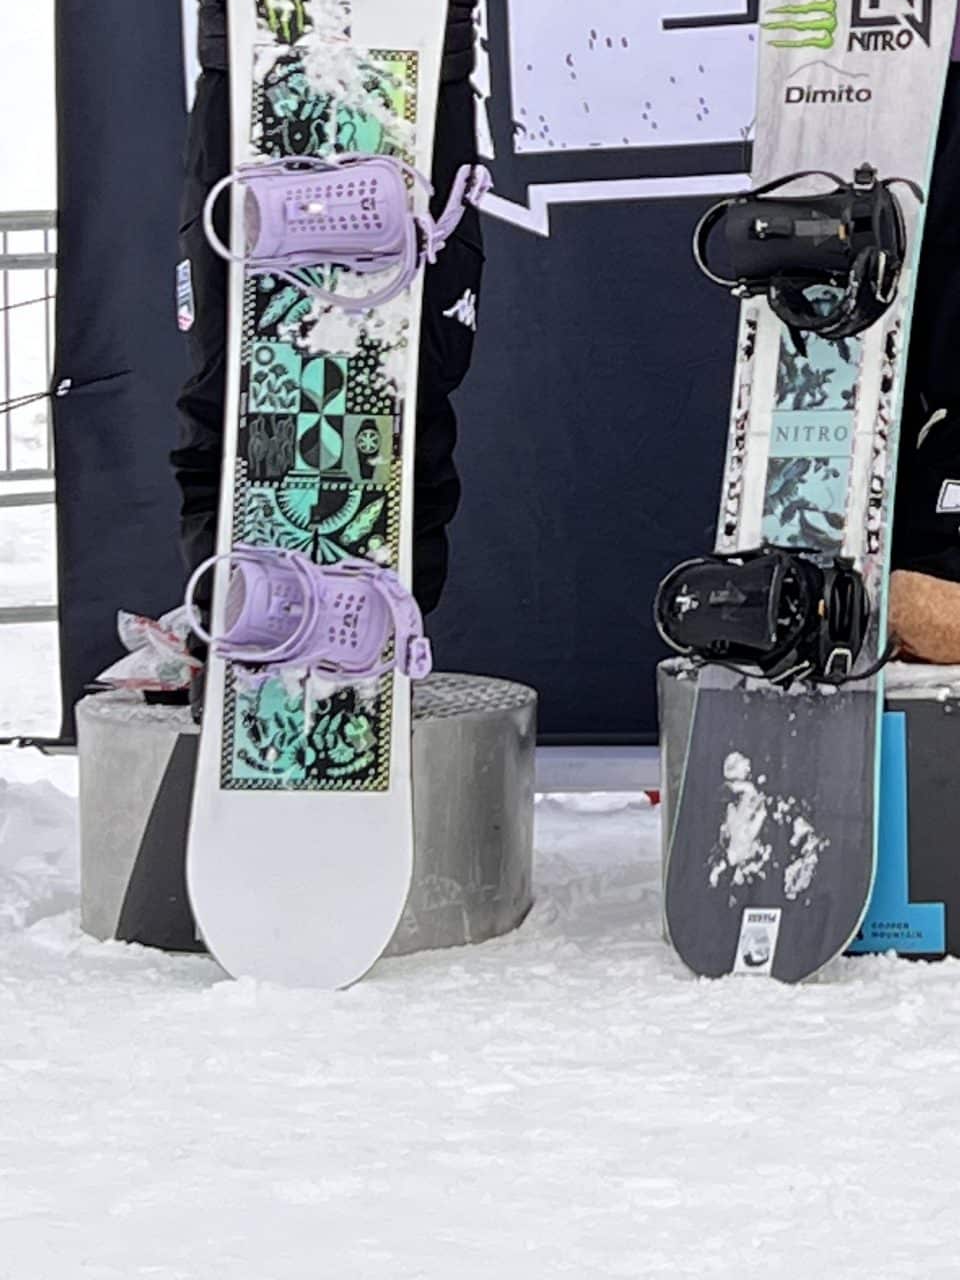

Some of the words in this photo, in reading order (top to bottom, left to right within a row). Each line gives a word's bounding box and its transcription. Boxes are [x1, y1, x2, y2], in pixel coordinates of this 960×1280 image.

[847, 29, 914, 53] NITRO
[784, 84, 873, 105] Dimito
[775, 425, 848, 442] NITRO
